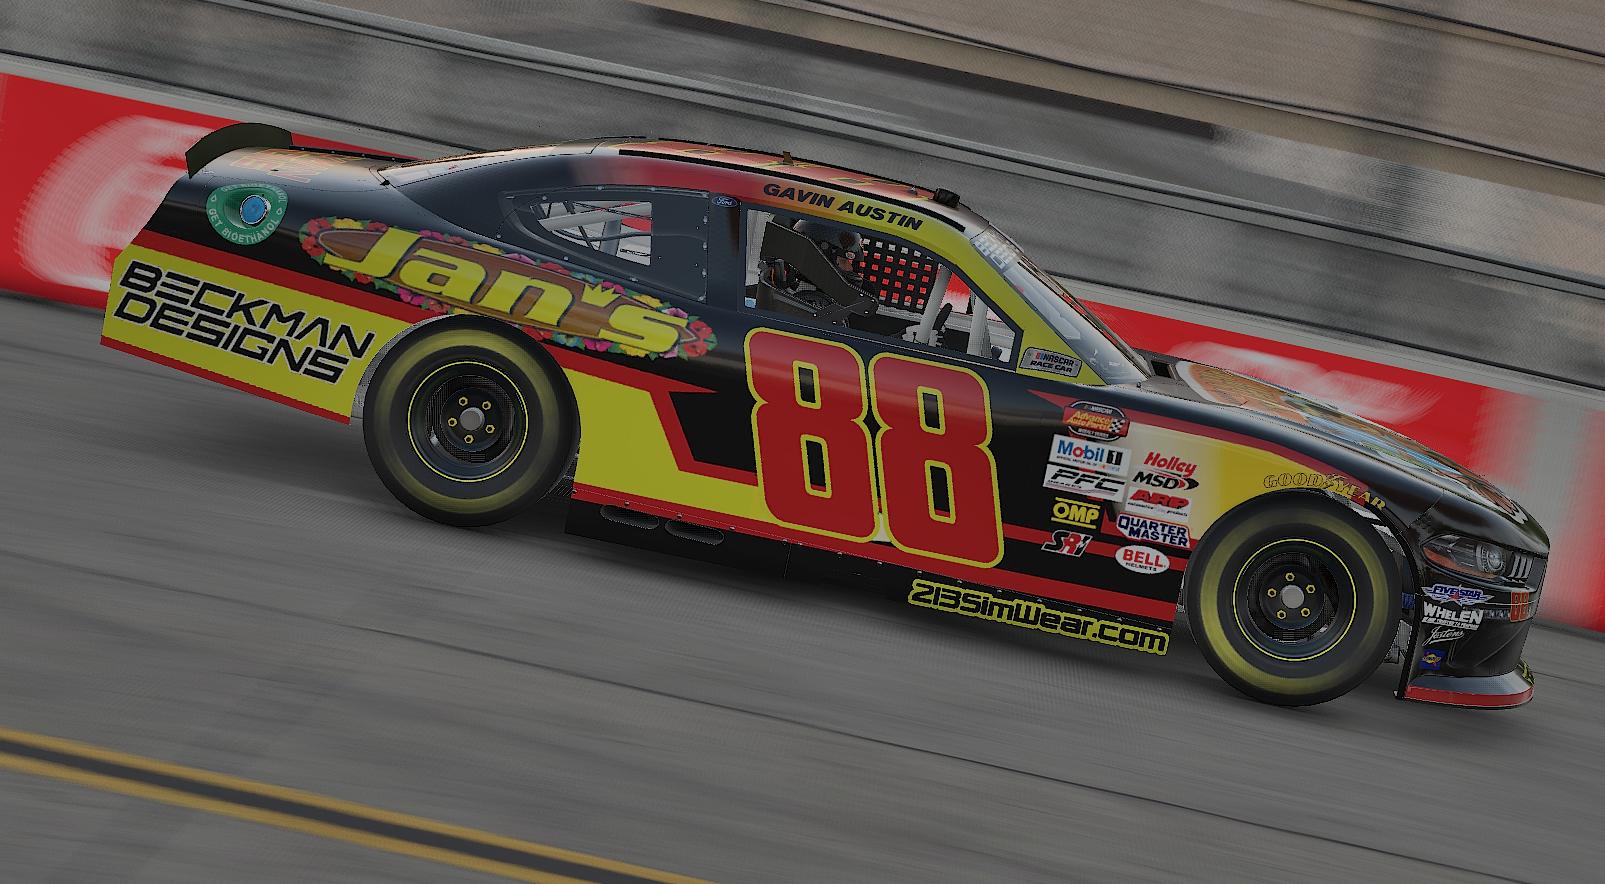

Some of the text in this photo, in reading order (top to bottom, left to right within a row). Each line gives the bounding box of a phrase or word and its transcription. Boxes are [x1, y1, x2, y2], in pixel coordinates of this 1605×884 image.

[763, 183, 924, 231] GAVIN AUSTIN
[208, 208, 279, 244] GET BIOETHANOL
[323, 227, 689, 353] Jan's
[119, 260, 376, 359] BECKMAN
[113, 291, 349, 384] DESIGNS
[1030, 360, 1073, 373] RACE CAR
[1042, 353, 1075, 367] NASCAR
[744, 327, 1004, 568] 88
[1057, 439, 1105, 462] Mobil
[1144, 451, 1197, 477] Holley
[1051, 468, 1126, 493] PFC
[1133, 471, 1180, 490] MSD
[1263, 472, 1387, 511] GOODYEAR
[1130, 489, 1190, 509] ARP
[1053, 502, 1100, 525] OMP
[1118, 515, 1187, 538] QUARTER
[1129, 526, 1188, 547] MASTER
[1123, 549, 1164, 568] BELL
[1125, 562, 1157, 572] HELMETS
[1433, 585, 1482, 600] FIVE STAR
[909, 580, 1168, 654] 213SimWear.com
[1423, 601, 1484, 625] WHELEN
